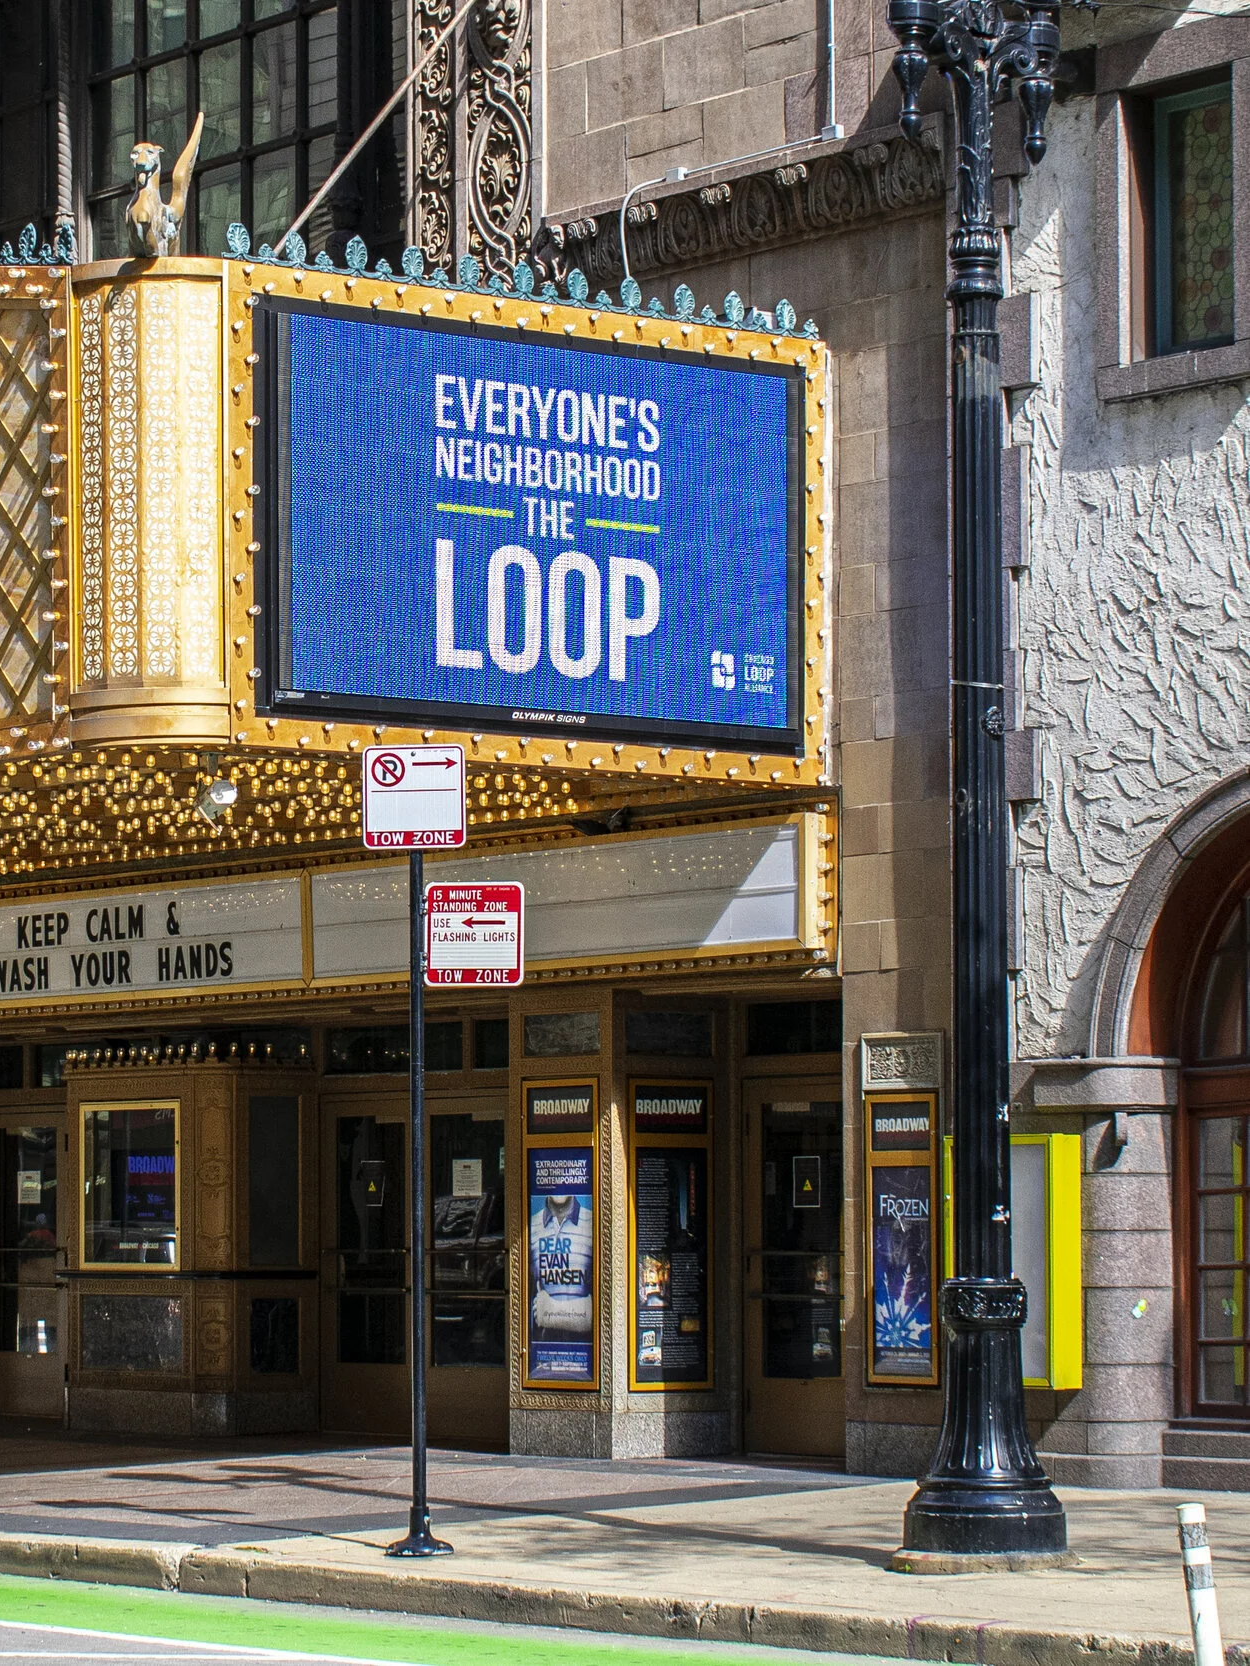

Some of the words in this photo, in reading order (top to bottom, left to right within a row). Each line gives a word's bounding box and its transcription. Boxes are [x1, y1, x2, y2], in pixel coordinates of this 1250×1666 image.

[434, 374, 661, 454] EVERYONE'S
[434, 436, 661, 502] NEIGHBORHOOD
[522, 496, 576, 541] THE
[434, 537, 661, 683] LOOP
[512, 711, 556, 722] OLYMPIK
[556, 714, 586, 724] SIGNS
[371, 832, 405, 845] TOW
[413, 831, 456, 844] ZONE
[433, 890, 444, 900] 15
[449, 890, 482, 900] MINUTE
[432, 902, 477, 912] STANDING
[484, 902, 508, 912] ZONE
[17, 911, 70, 949] KEEP
[86, 904, 144, 943] CALM
[166, 901, 180, 936] &
[433, 918, 451, 928] USE
[432, 932, 477, 942] FLASHING
[483, 932, 516, 942] LIGHTS
[70, 950, 132, 987] YOUR
[157, 941, 233, 982] HANDS
[437, 970, 463, 983] TOW
[476, 969, 510, 983] ZONE
[533, 1099, 590, 1115] BROADWAY
[636, 1099, 702, 1115] BROADWAY
[875, 1117, 929, 1133] BROADWAY
[536, 1168, 549, 1176] AND
[549, 1168, 587, 1176] THRILLINGLY
[879, 1194, 929, 1220] FROZEN
[539, 1238, 572, 1253] DEAR
[539, 1254, 569, 1269] EVAN
[539, 1269, 587, 1285] HANSEN
